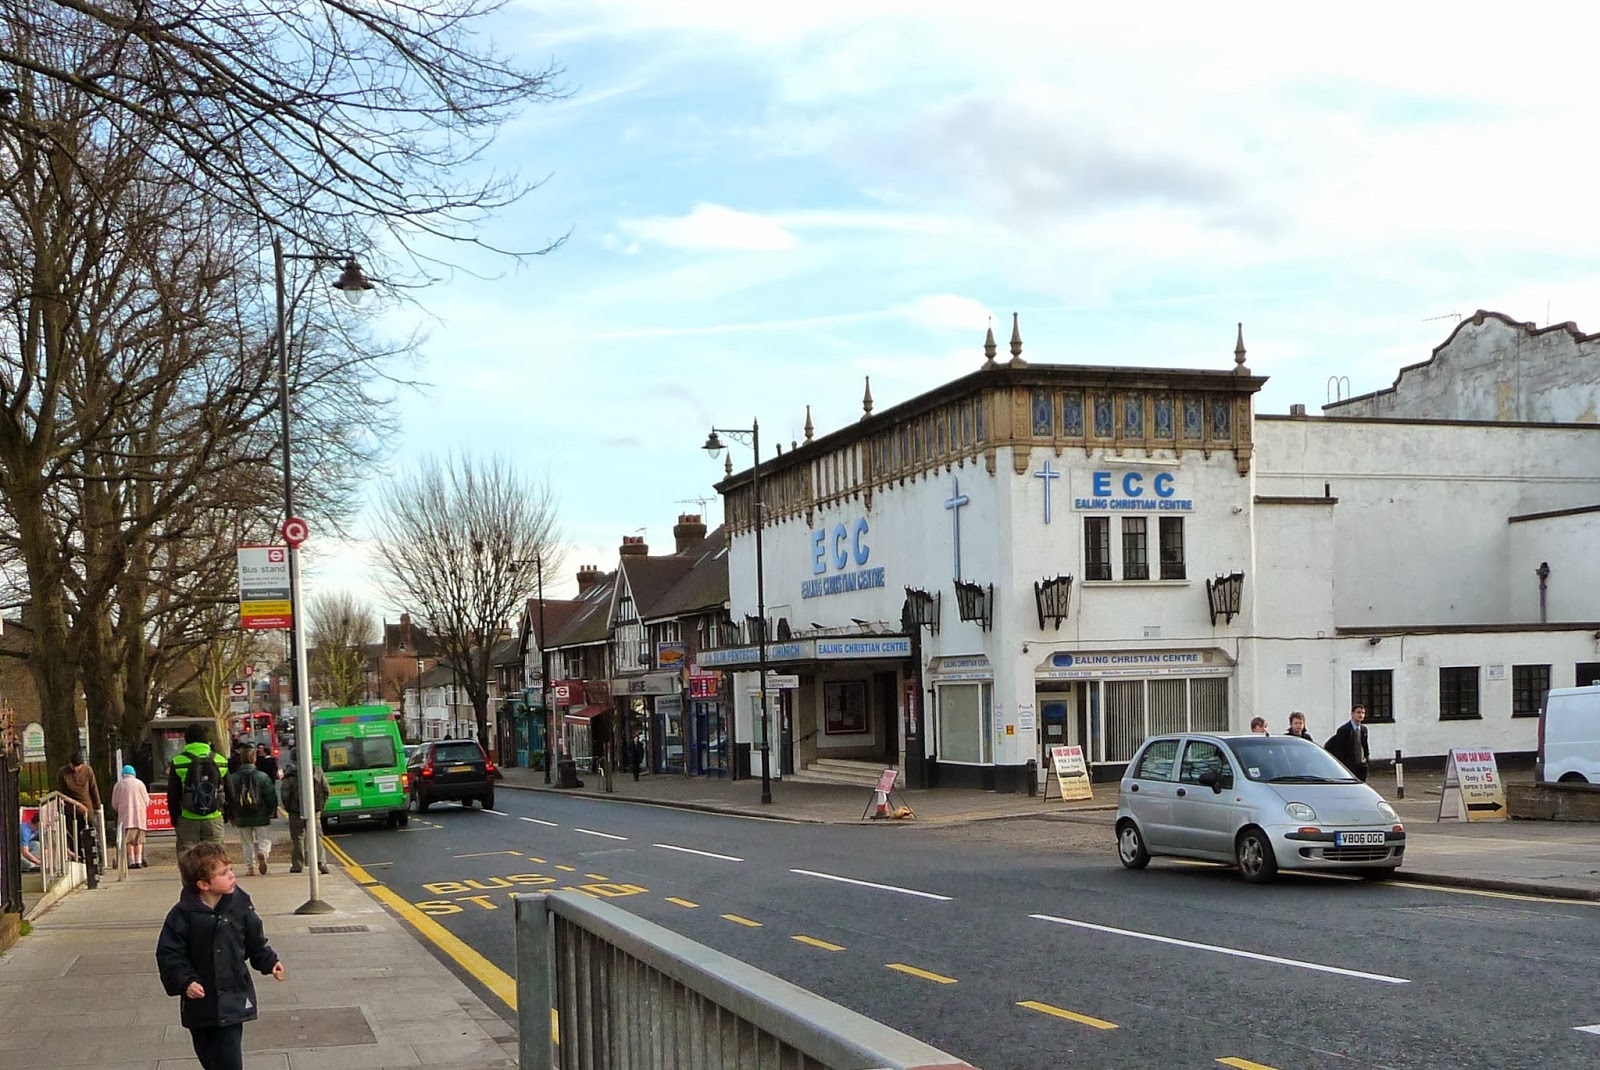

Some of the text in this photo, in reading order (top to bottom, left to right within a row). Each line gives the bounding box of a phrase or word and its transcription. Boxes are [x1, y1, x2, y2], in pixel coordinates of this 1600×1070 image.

[1075, 499, 1192, 510] EALING CHRISTIAN CENTRE
[286, 523, 304, 540] Q
[802, 567, 885, 599] EALING CHRISTIAN CENTRE
[774, 644, 800, 657] CHURCH
[818, 642, 908, 654] EALING CHRISTIAN CENTRE
[1075, 656, 1108, 664] EALING
[1111, 655, 1160, 663] CHRISTIAN
[1456, 752, 1491, 762] HAND CAR WASH
[422, 874, 557, 896] BUS
